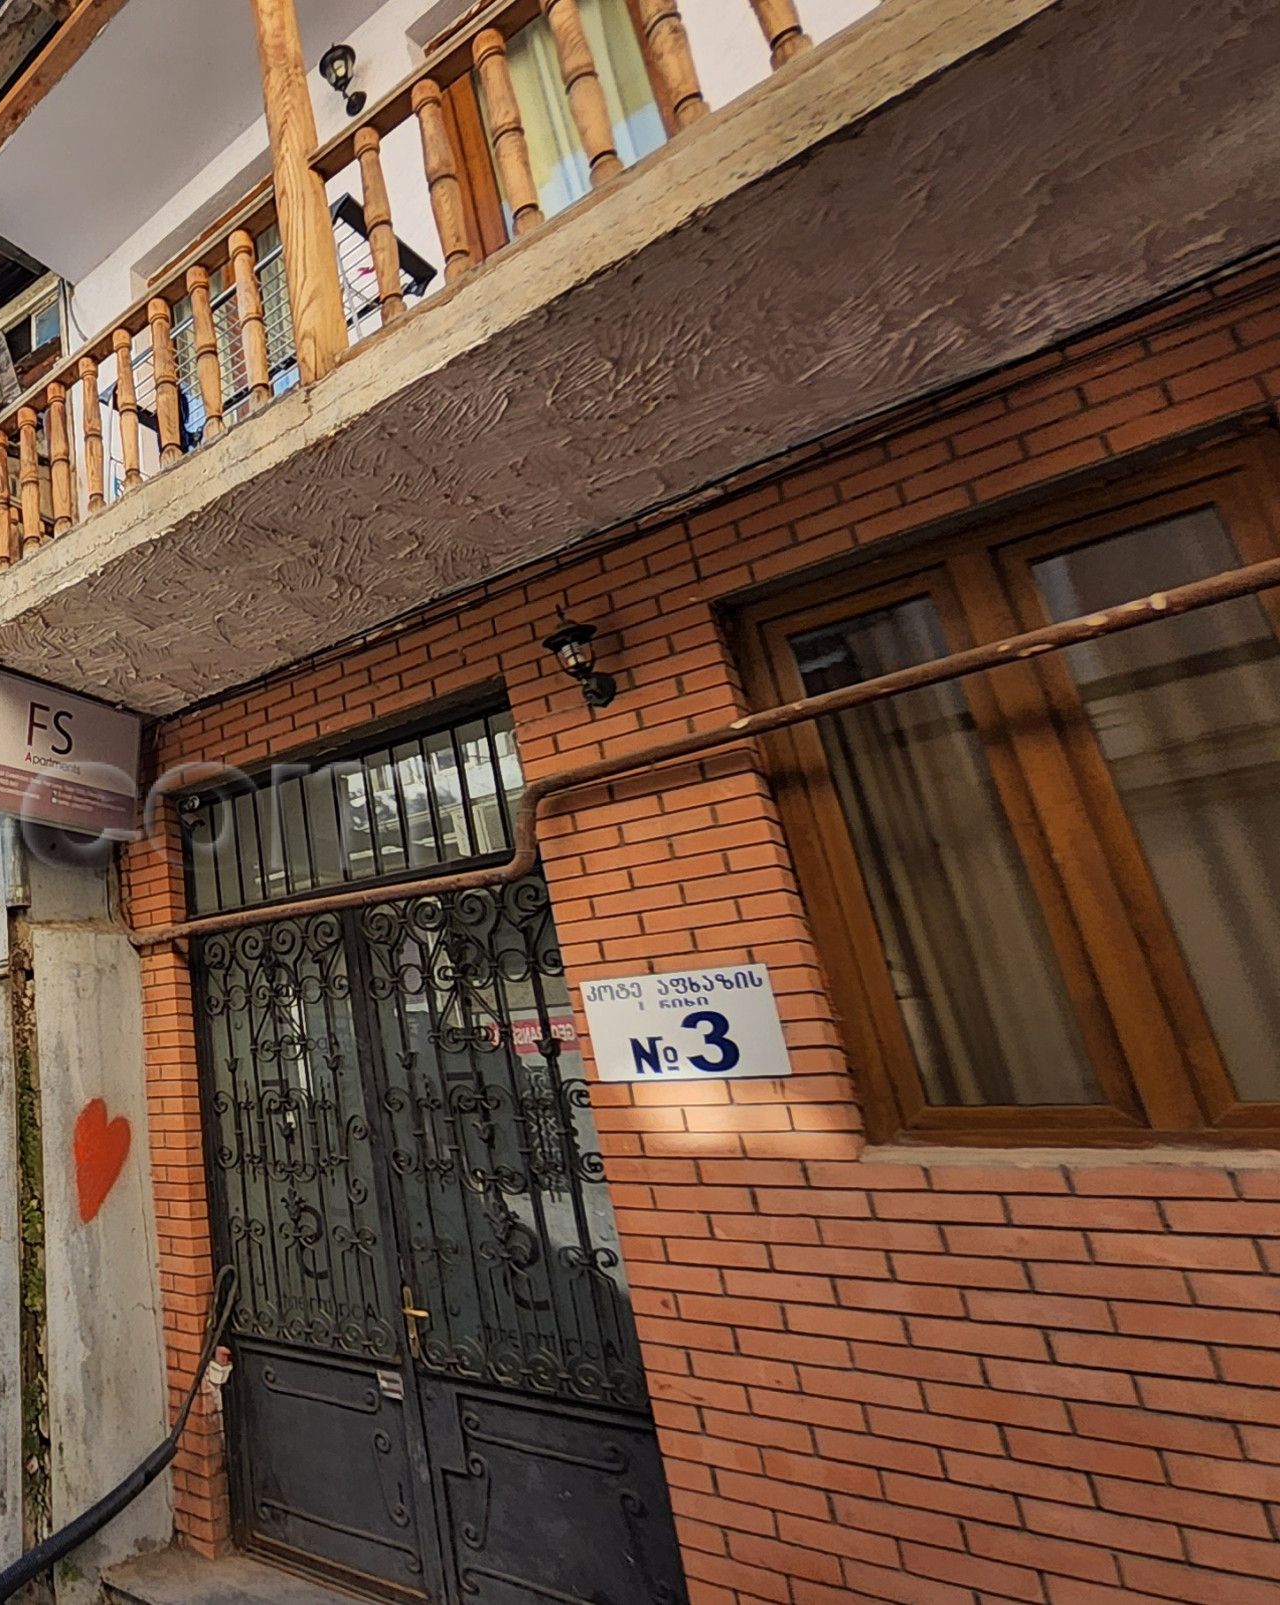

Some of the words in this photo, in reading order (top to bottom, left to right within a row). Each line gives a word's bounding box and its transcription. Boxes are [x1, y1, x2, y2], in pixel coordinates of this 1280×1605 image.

[27, 702, 74, 756] FS
[25, 753, 82, 777] Apartments
[586, 981, 642, 1003] კოტე
[657, 970, 763, 997] აფხაზის
